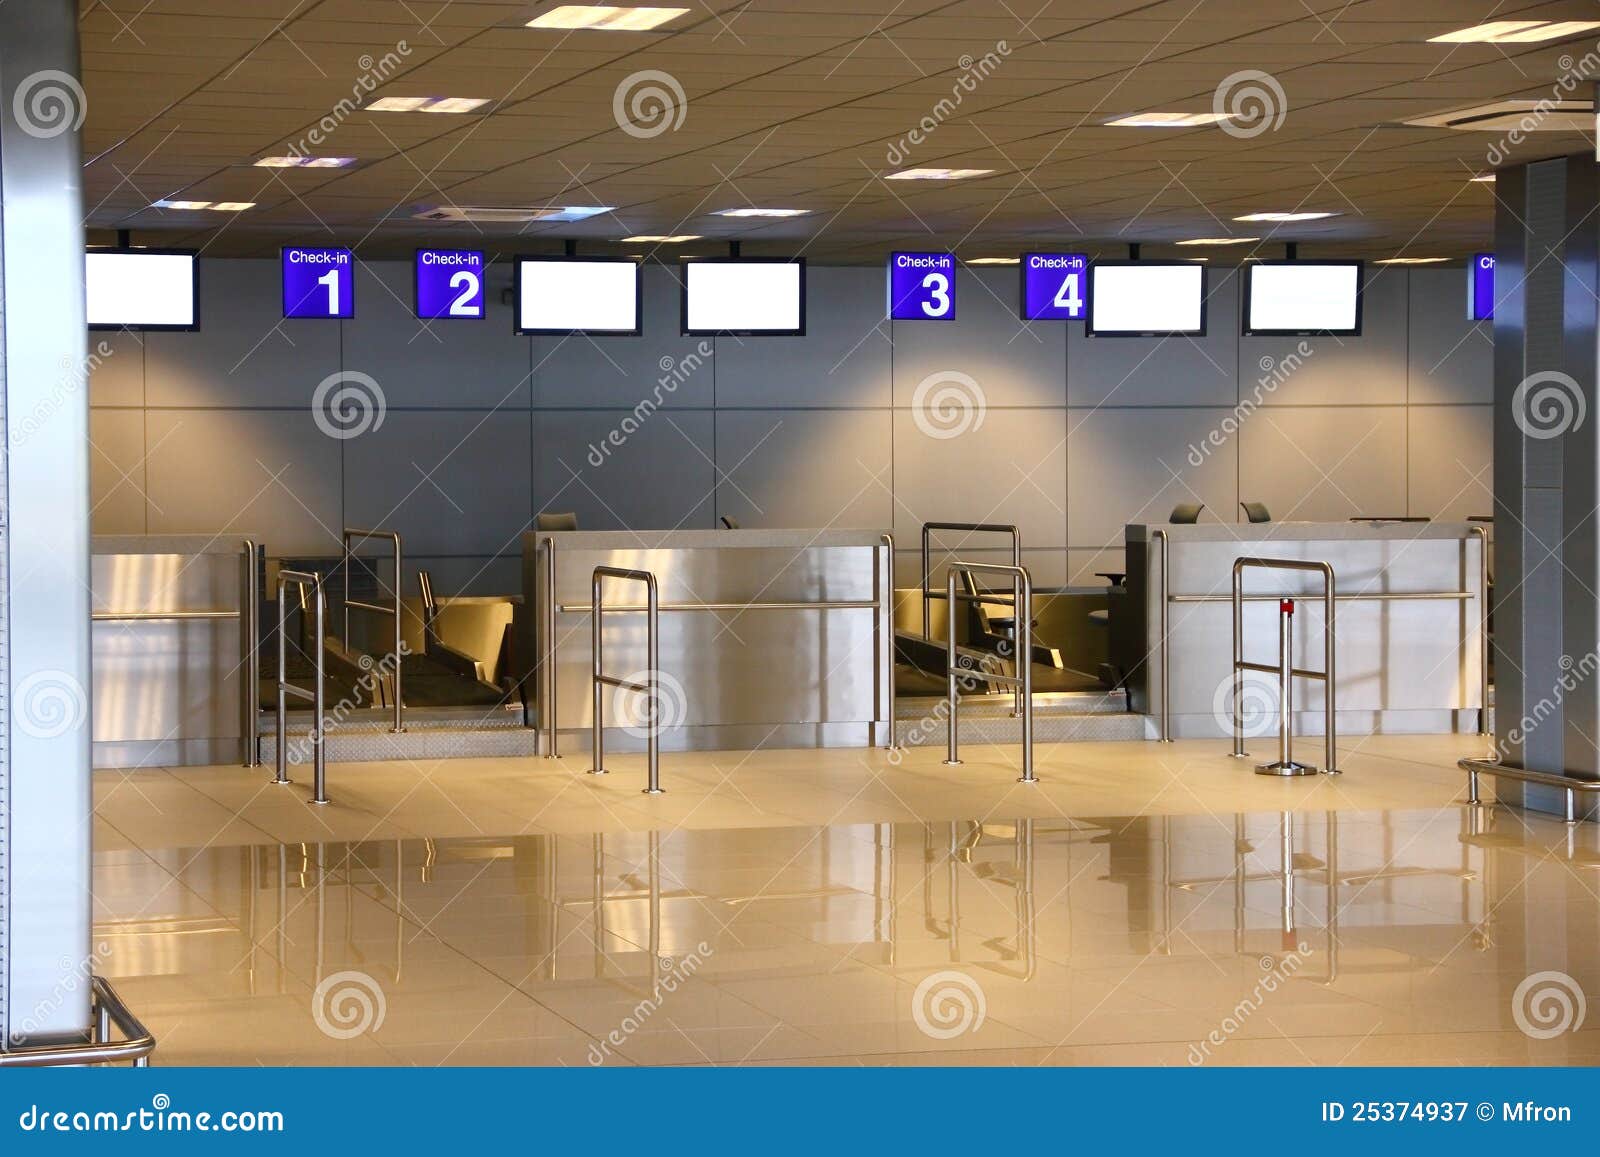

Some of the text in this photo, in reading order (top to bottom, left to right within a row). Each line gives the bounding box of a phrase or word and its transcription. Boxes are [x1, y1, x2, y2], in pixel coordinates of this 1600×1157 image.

[289, 250, 348, 264] Check-in
[422, 252, 479, 265] Check-in
[897, 255, 950, 268] Check-in
[1030, 256, 1083, 269] Check-in
[318, 269, 339, 315] 1
[449, 270, 480, 316] 2
[921, 272, 950, 317] 3
[1053, 273, 1083, 317] 4
